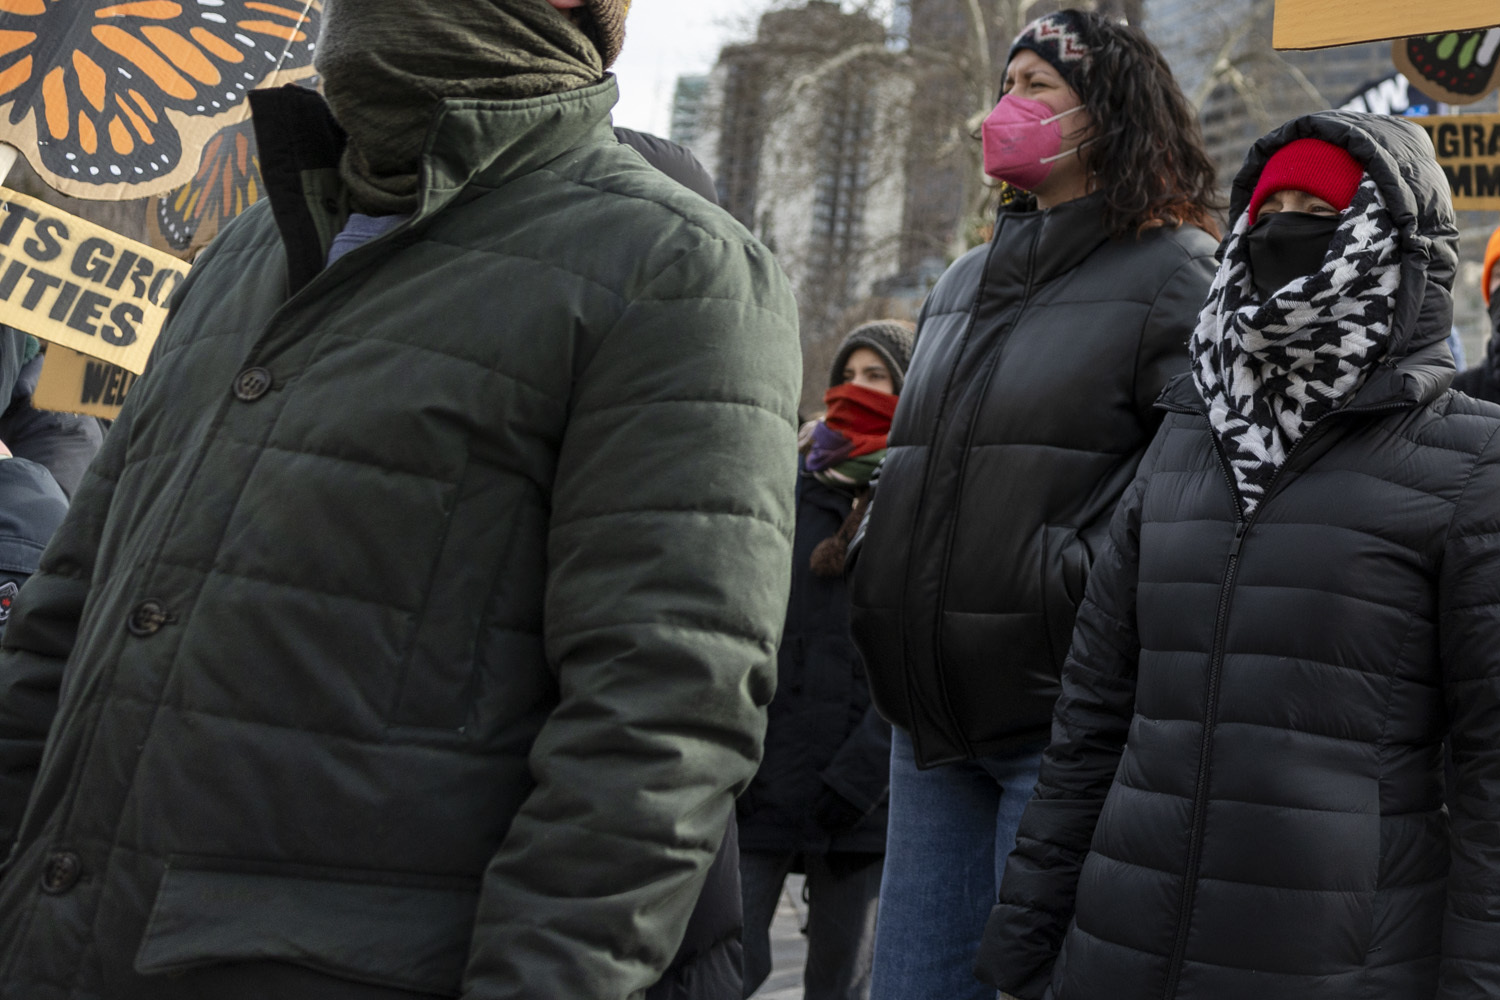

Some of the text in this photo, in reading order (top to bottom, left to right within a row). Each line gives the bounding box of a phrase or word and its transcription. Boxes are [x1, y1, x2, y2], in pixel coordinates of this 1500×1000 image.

[0, 199, 69, 262] TS
[0, 253, 144, 347] ITIES
[81, 361, 138, 406] WEL
